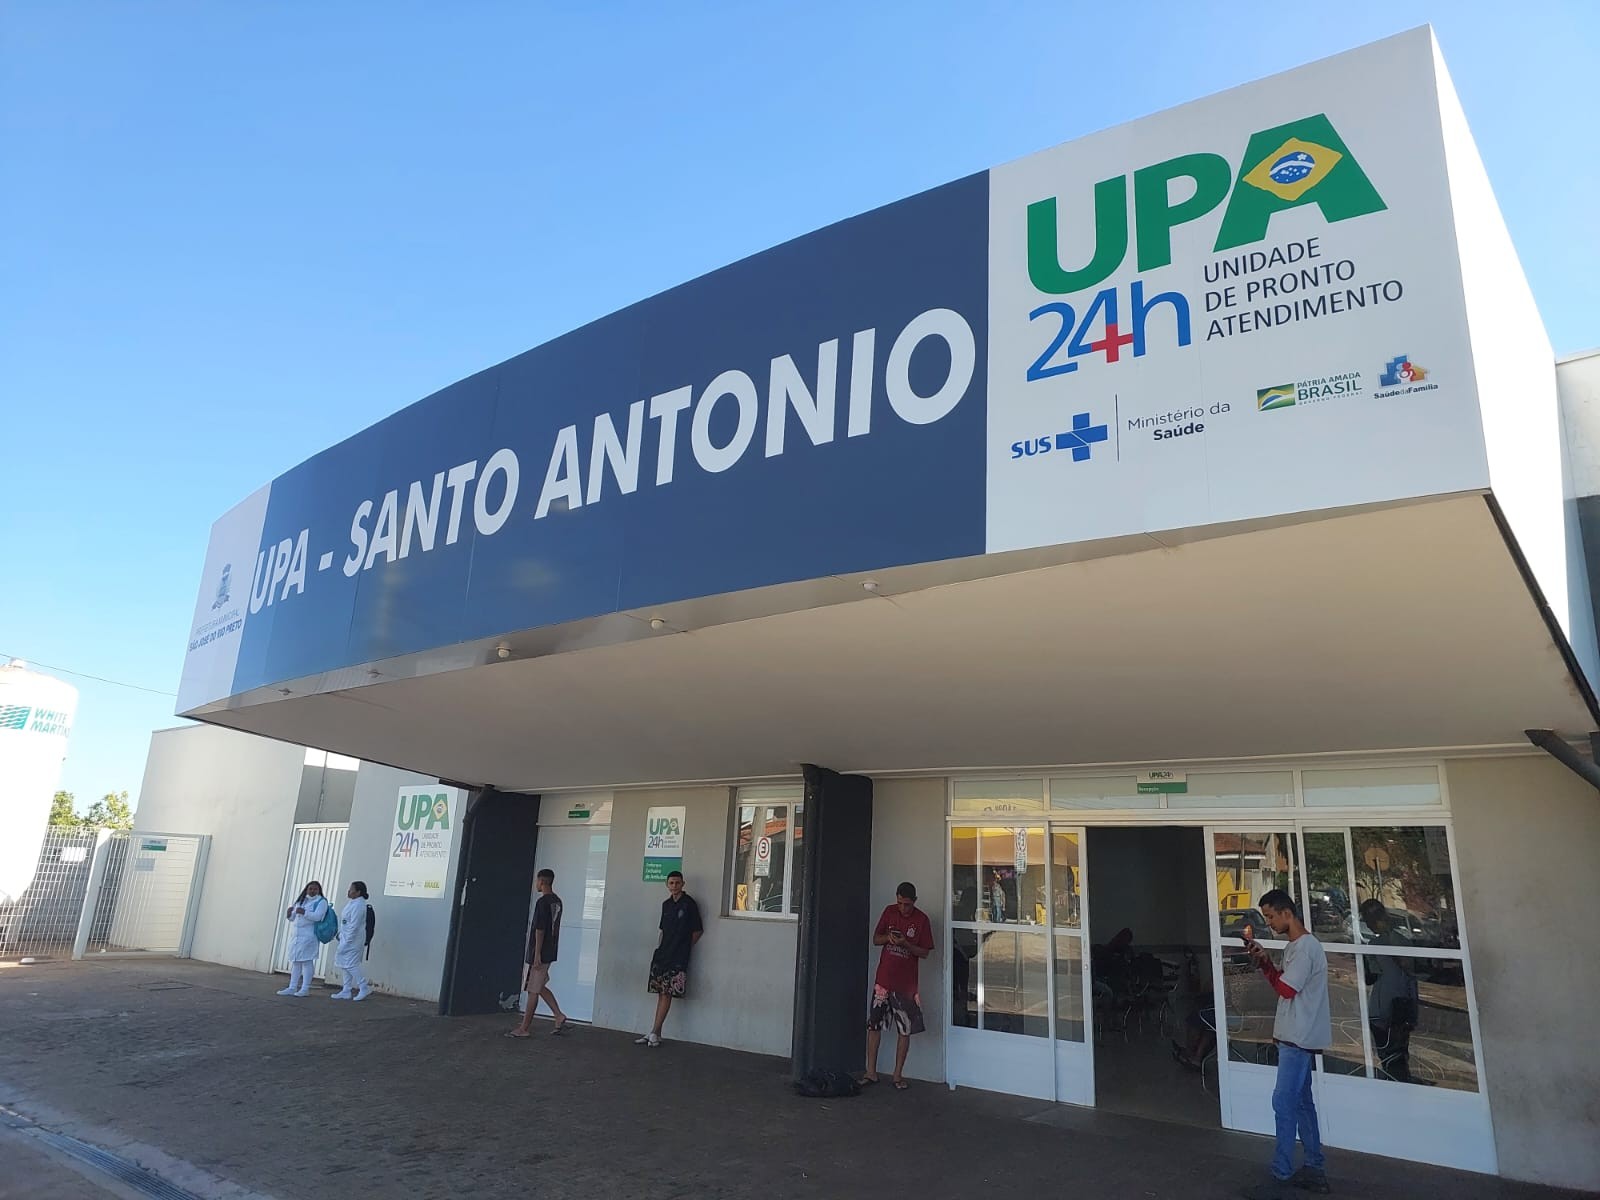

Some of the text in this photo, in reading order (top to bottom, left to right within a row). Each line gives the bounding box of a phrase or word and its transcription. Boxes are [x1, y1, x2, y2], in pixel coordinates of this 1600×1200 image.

[1027, 113, 1388, 295] UPA
[1204, 237, 1321, 283] UNIDADE
[1205, 259, 1356, 312] DE PRONTO
[1206, 280, 1404, 341] ATENDIMENTO
[1026, 280, 1192, 382] 24h
[1298, 380, 1363, 401] BRASIL
[1329, 371, 1361, 383] AMADA
[1127, 401, 1231, 431] Ministério da
[1153, 420, 1204, 441] Saúde
[249, 528, 309, 615] UPA
[343, 448, 520, 577] SANTO
[534, 308, 976, 519] ANTONIO
[1011, 436, 1052, 459] SUS
[34, 708, 68, 724] WHITE
[398, 793, 450, 831] UPA
[649, 817, 680, 836] UPA
[392, 832, 419, 858] 24h
[647, 835, 664, 848] 24h
